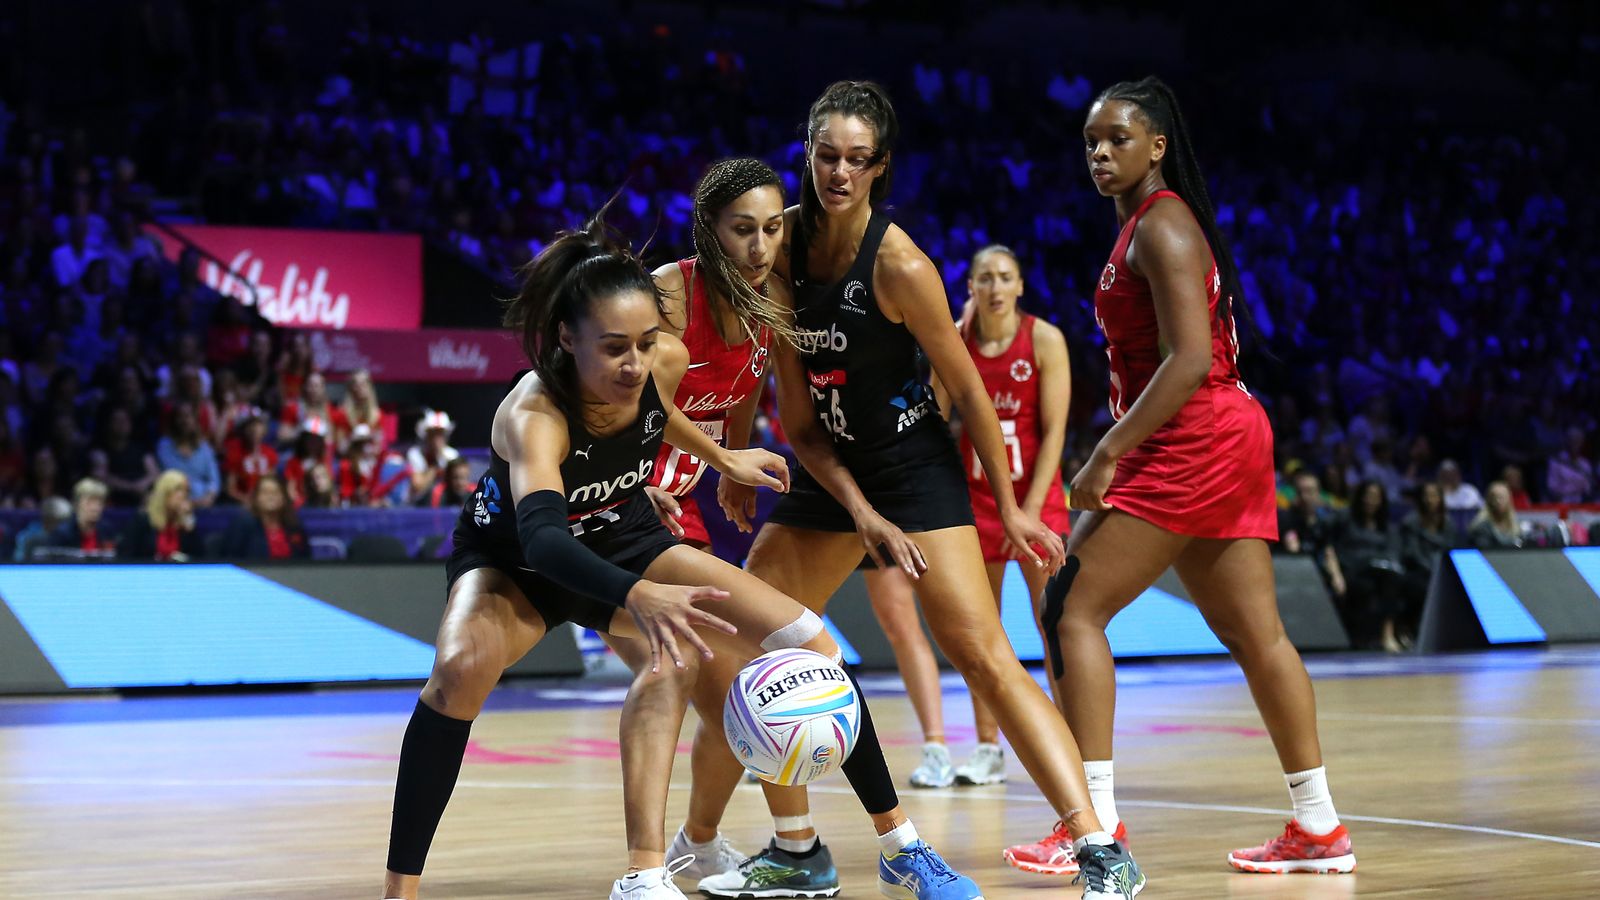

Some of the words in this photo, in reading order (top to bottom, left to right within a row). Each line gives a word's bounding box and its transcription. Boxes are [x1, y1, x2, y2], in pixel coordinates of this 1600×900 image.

[681, 391, 746, 412] Vitalit
[993, 391, 1021, 416] lity
[569, 459, 653, 502] myob
[660, 448, 709, 497] G
[756, 668, 846, 708] GILBERT
